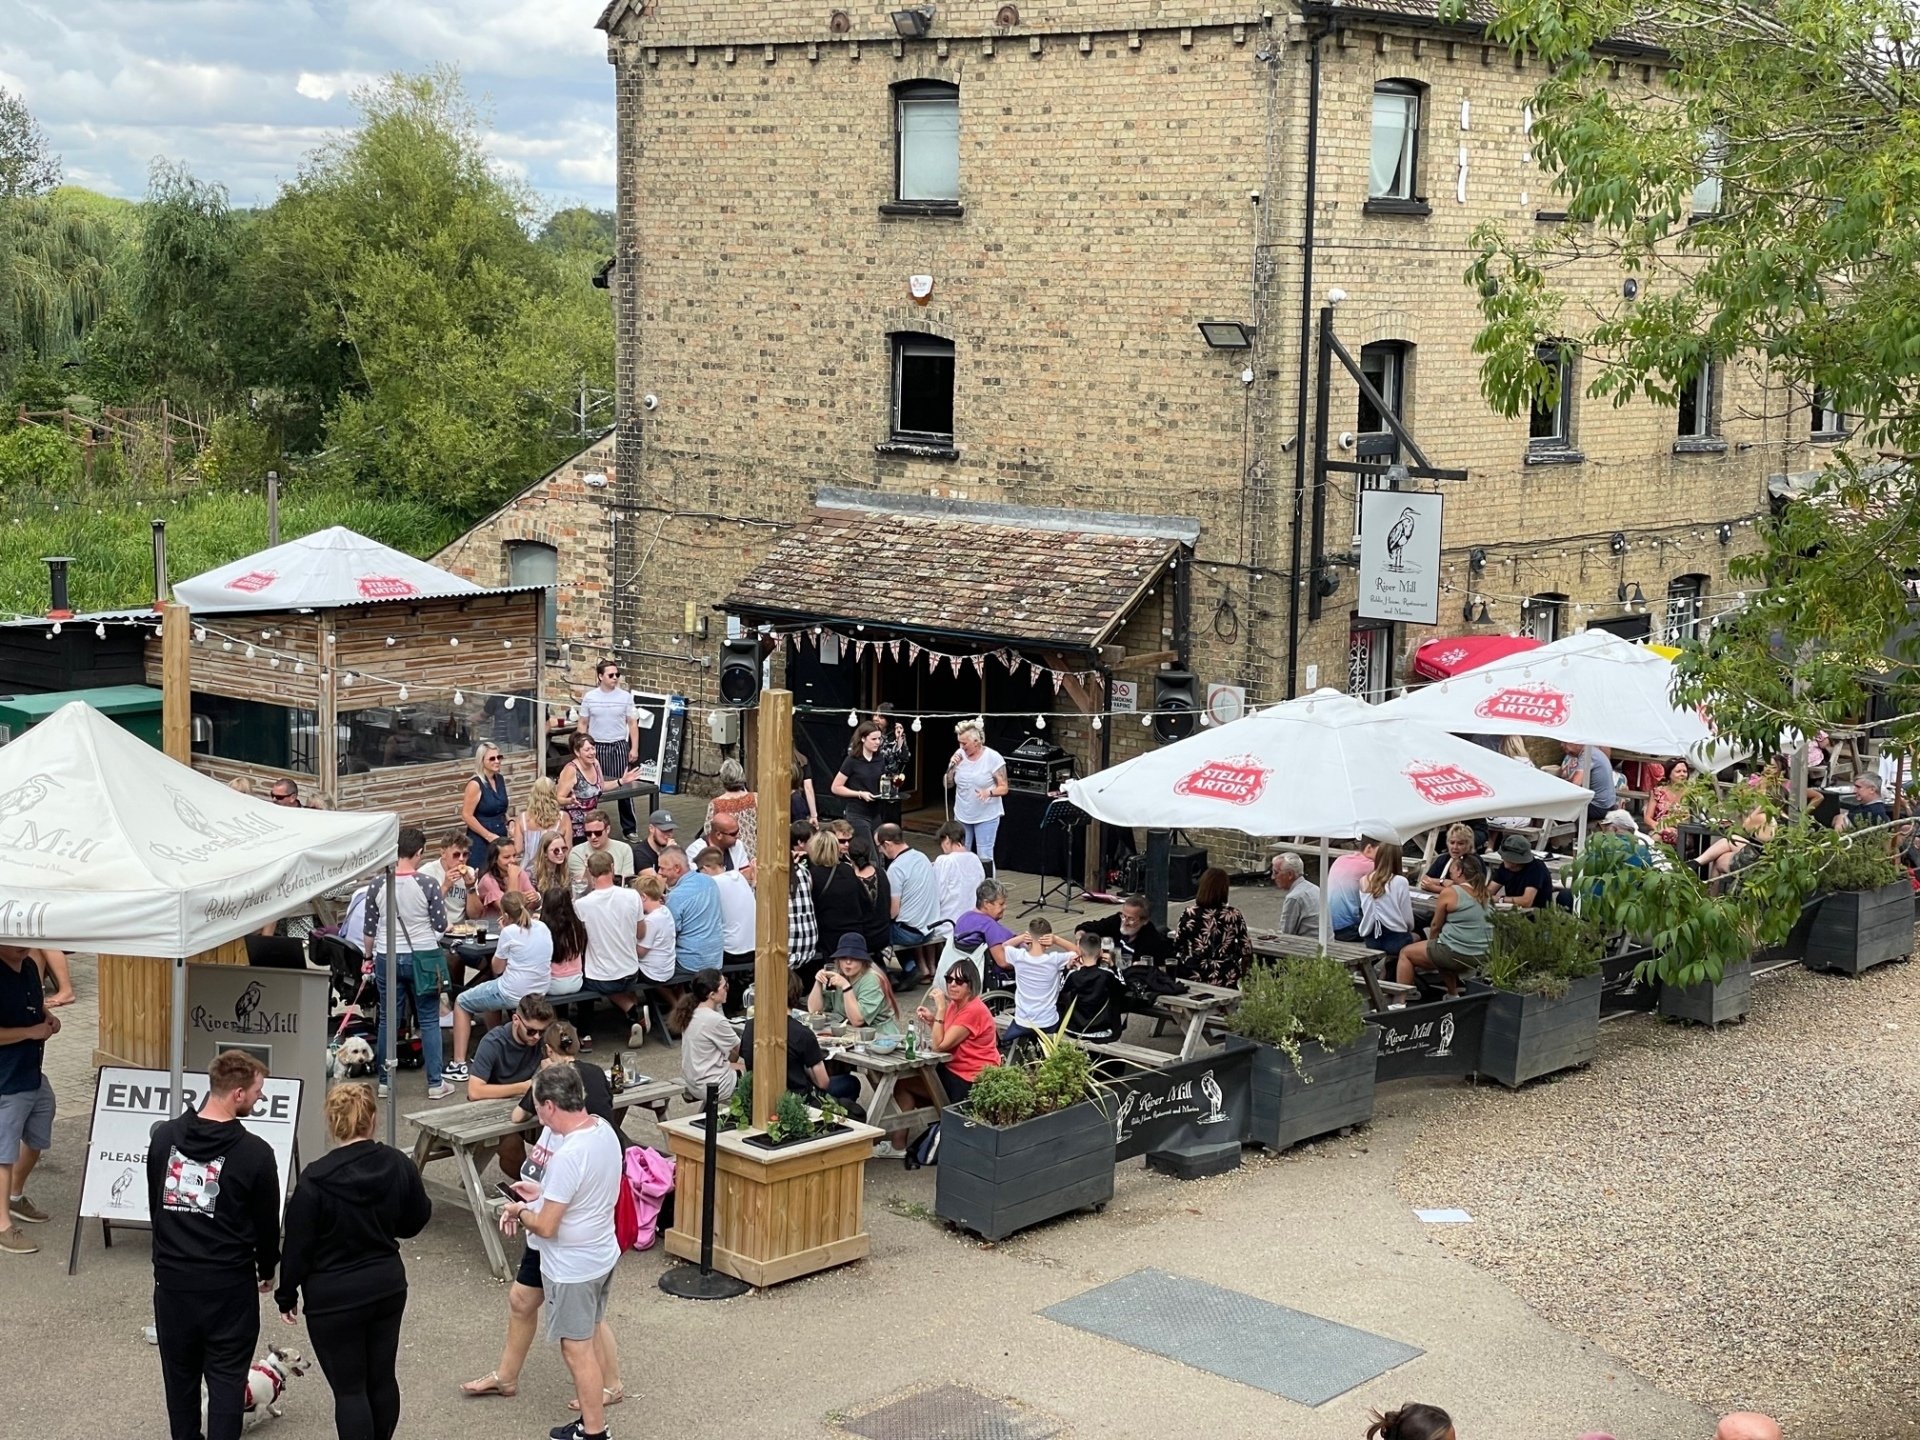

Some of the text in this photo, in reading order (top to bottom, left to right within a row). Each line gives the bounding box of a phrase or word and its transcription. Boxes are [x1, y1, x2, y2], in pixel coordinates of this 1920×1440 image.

[1375, 577, 1417, 593] River Mill
[1500, 694, 1557, 708] STELLA
[1492, 703, 1554, 718] ARTOIS
[1201, 768, 1256, 785] STELLA
[1418, 773, 1468, 787] STELLA
[1191, 778, 1251, 796] ARTOIS
[1428, 781, 1478, 797] ARTOIS
[12, 820, 104, 863] Mill
[149, 840, 226, 866] River
[216, 811, 284, 841] Mill
[204, 896, 236, 922] Public
[328, 855, 346, 878] and
[191, 1004, 299, 1033] River Mill
[1384, 1021, 1435, 1047] River Mill
[106, 1083, 291, 1119] ENTRCE
[1139, 1080, 1193, 1112] River Mill
[99, 1151, 149, 1164] PLEASE
